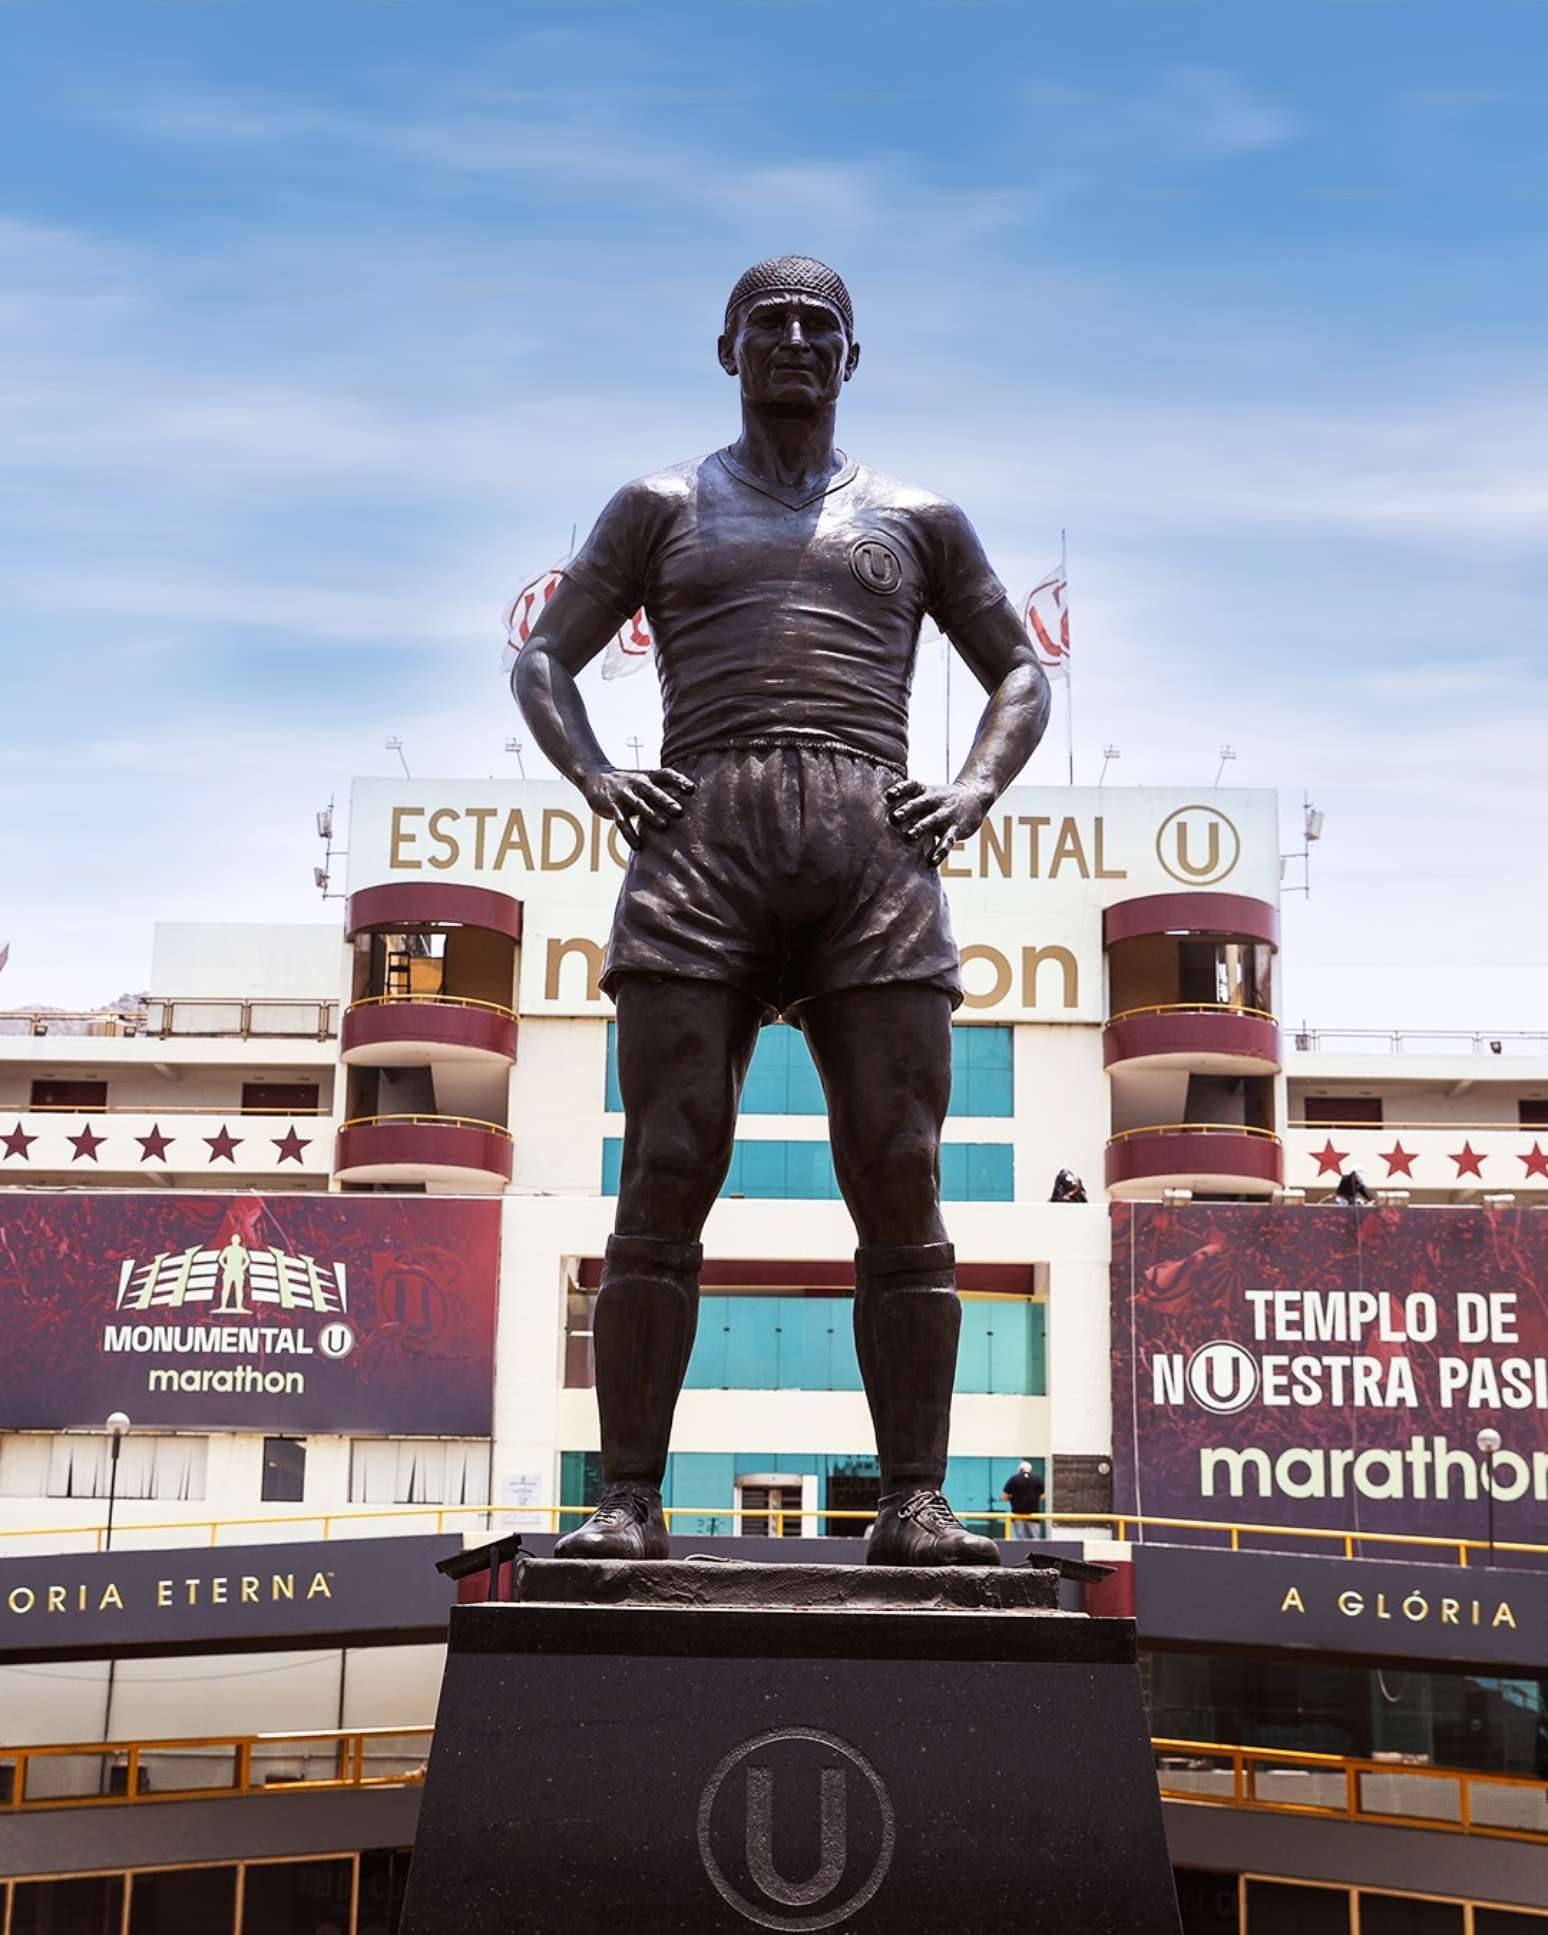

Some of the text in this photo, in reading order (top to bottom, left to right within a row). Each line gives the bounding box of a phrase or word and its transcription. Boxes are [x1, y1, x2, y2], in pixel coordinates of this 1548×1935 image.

[861, 549, 893, 586] U
[1245, 1290, 1519, 1343] TEMPLO DE
[103, 1325, 314, 1355] MONUMENTAL
[148, 1366, 305, 1394] marathon
[1153, 1353, 1418, 1408] NUESTRA
[1200, 1435, 1548, 1501] maratho
[8, 1571, 332, 1614] ORIA ETERNA
[1281, 1587, 1517, 1629] A GLÓRIA
[746, 1765, 847, 1906] U
